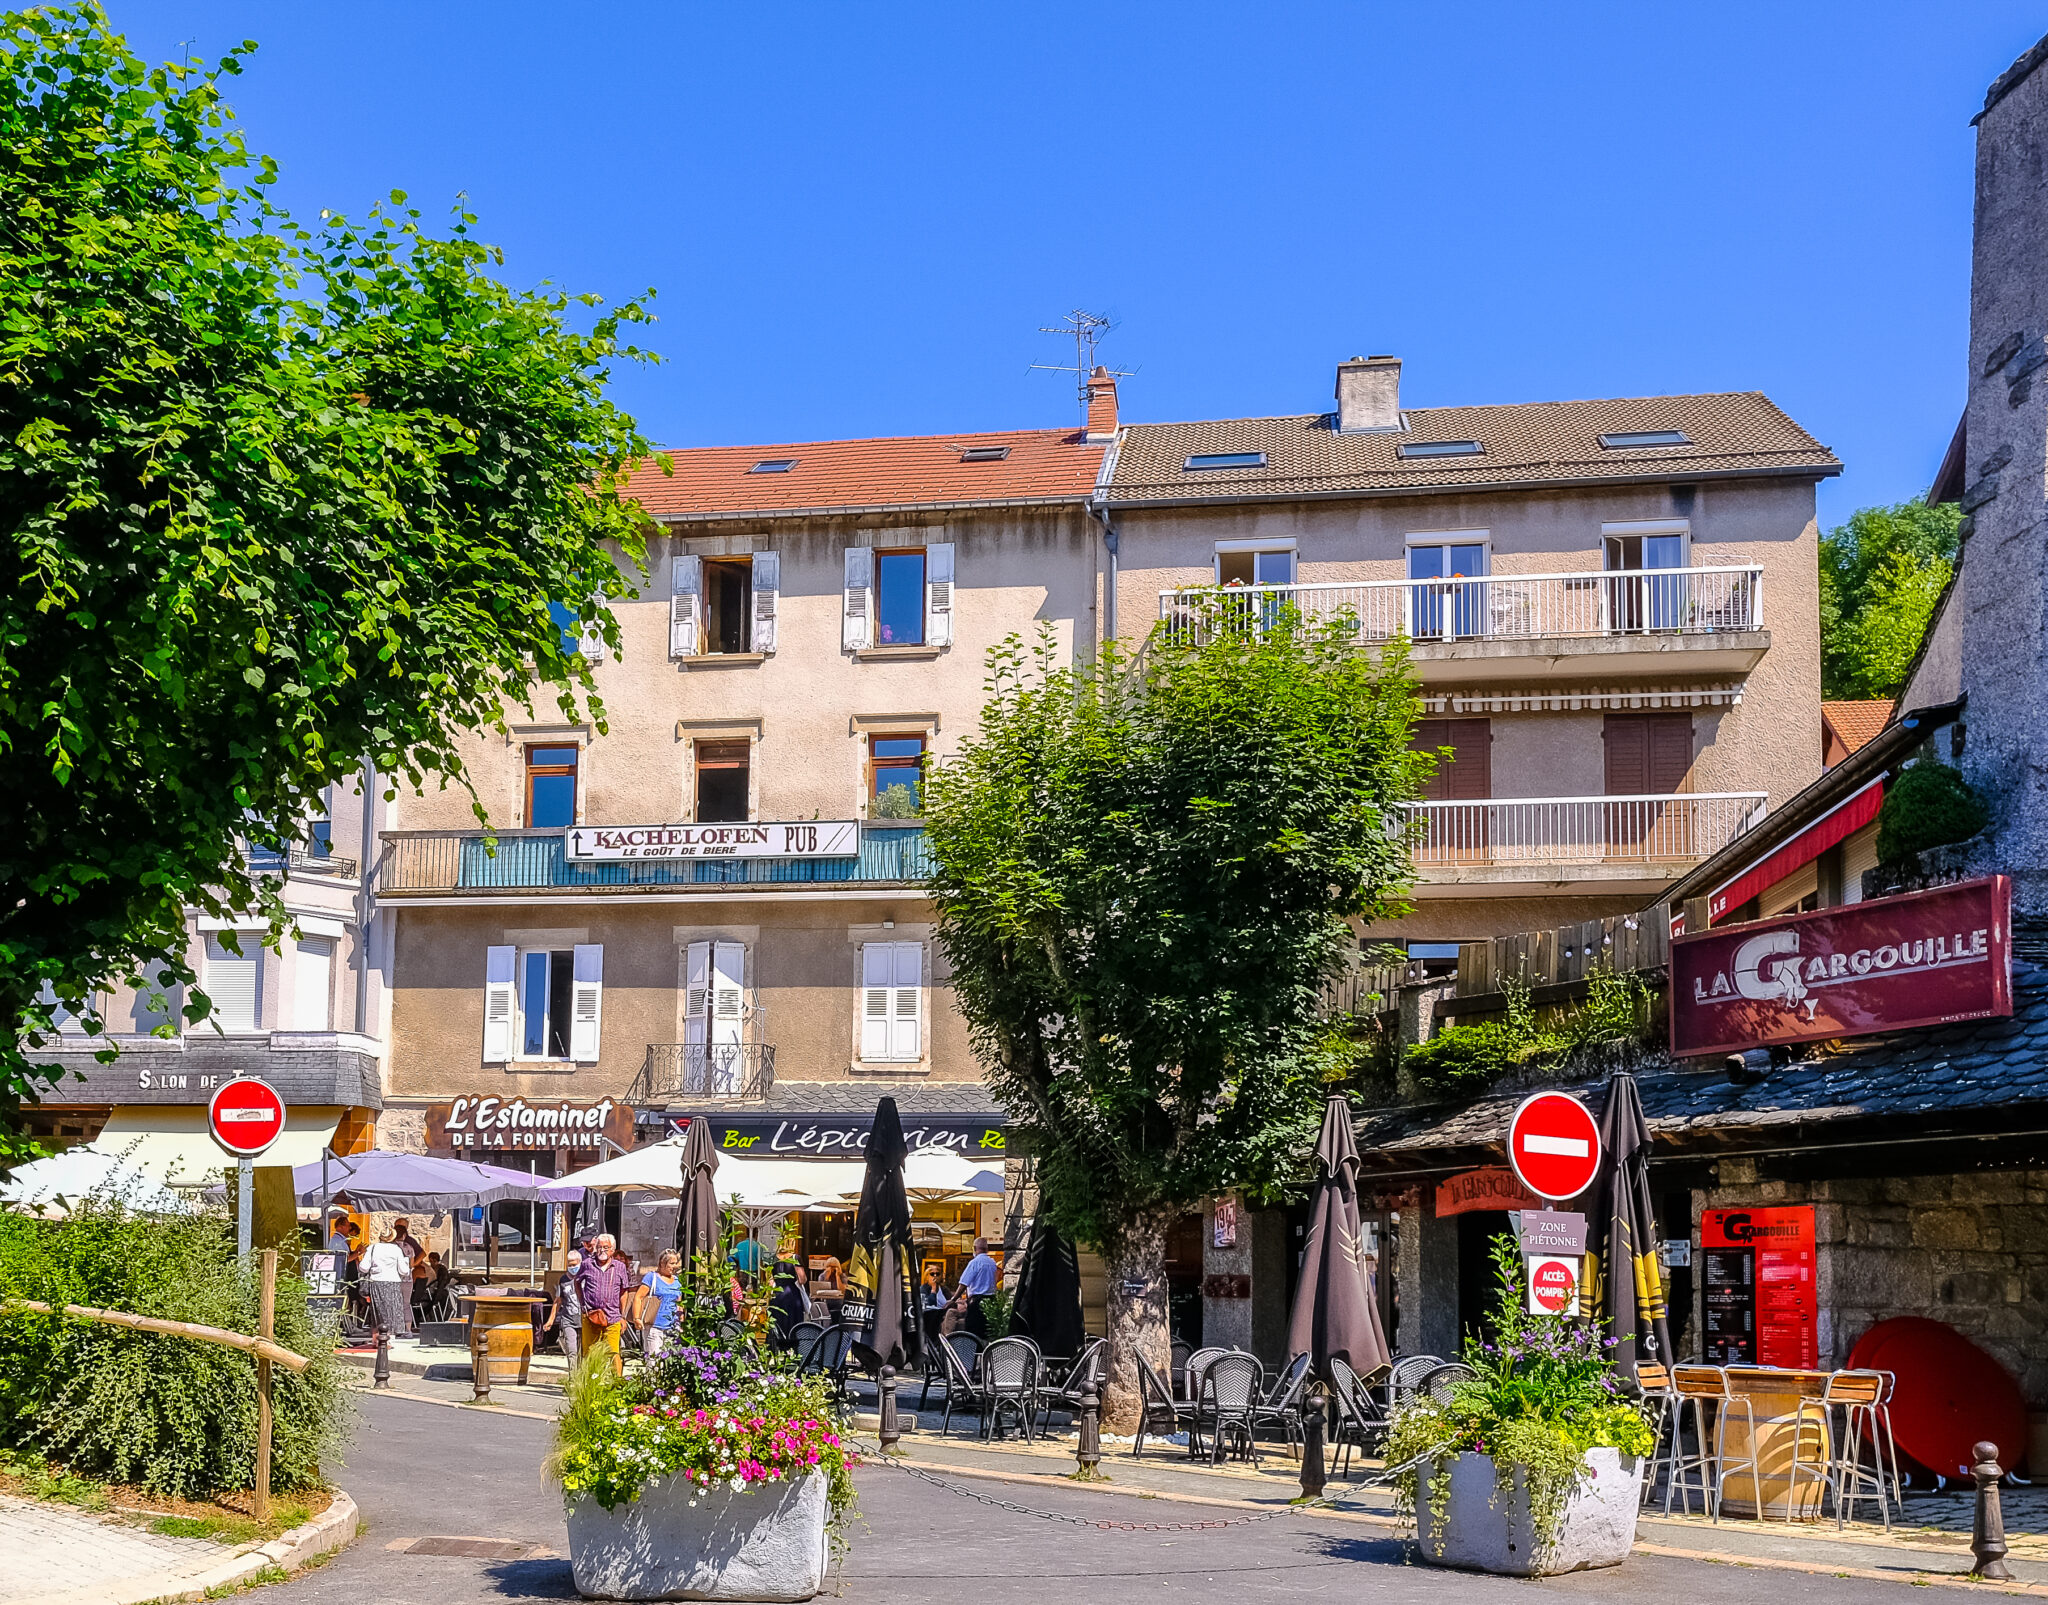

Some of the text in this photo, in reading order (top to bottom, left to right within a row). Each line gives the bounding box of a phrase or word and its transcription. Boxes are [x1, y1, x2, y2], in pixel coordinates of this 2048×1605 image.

[594, 826, 818, 853] KACHELOFEN PUB
[623, 848, 637, 856] LE
[681, 847, 696, 856] DE
[703, 846, 737, 855] BIERE
[1693, 928, 1988, 1000] LA GARGOUILLE
[200, 1075, 218, 1089] DE
[444, 1098, 613, 1130] L'Estaminet
[452, 1133, 603, 1146] DE LA FONTAINE
[722, 1129, 760, 1149] Bar
[770, 1121, 968, 1154] L'épicrien
[1540, 1222, 1567, 1232] ZONE
[1529, 1234, 1578, 1247] PIÉTONNE
[1542, 1269, 1565, 1282] ACCÈS
[1535, 1286, 1573, 1298] POMPIES
